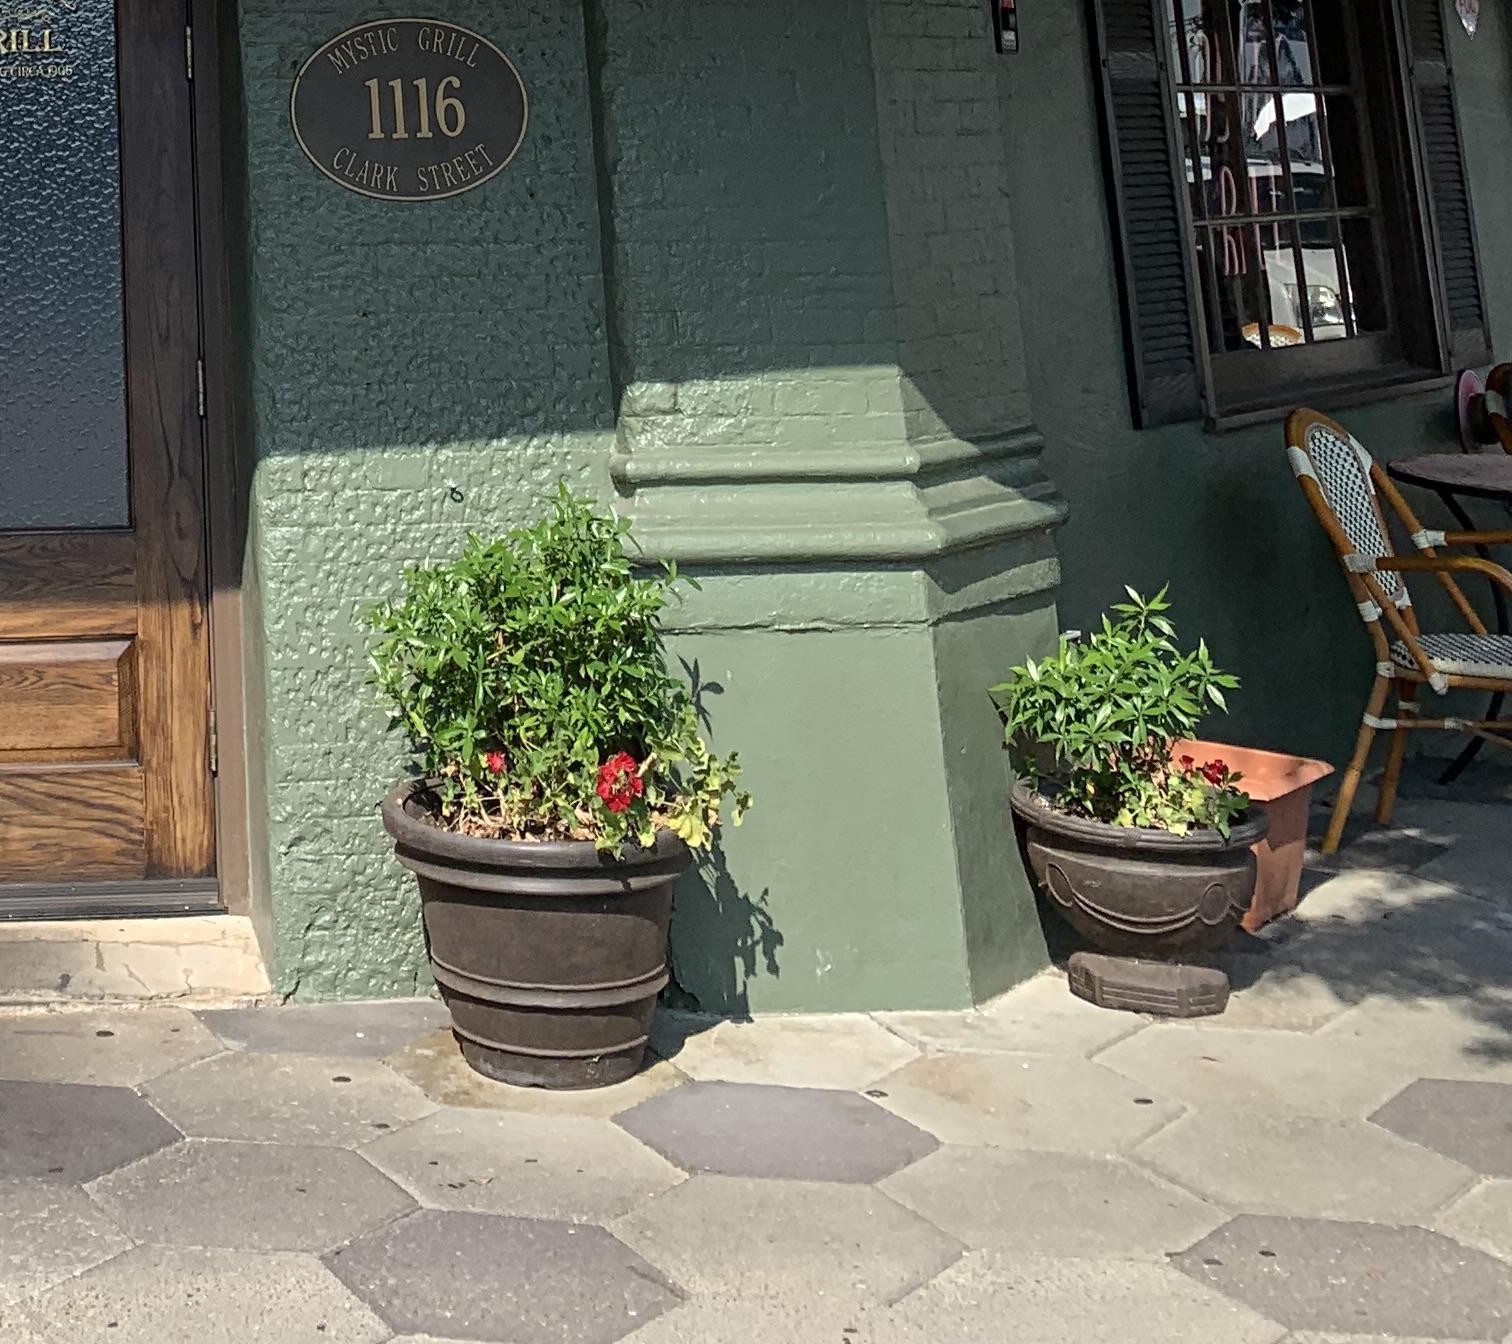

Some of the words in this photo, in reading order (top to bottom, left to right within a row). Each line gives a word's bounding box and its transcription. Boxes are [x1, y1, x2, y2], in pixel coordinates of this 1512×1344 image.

[9, 65, 44, 78] CIRCA
[327, 27, 399, 75] MYSTIC
[417, 26, 480, 68] GRILL
[364, 75, 466, 140] 1116
[332, 147, 399, 192] CLARK
[417, 143, 494, 192] STREET
